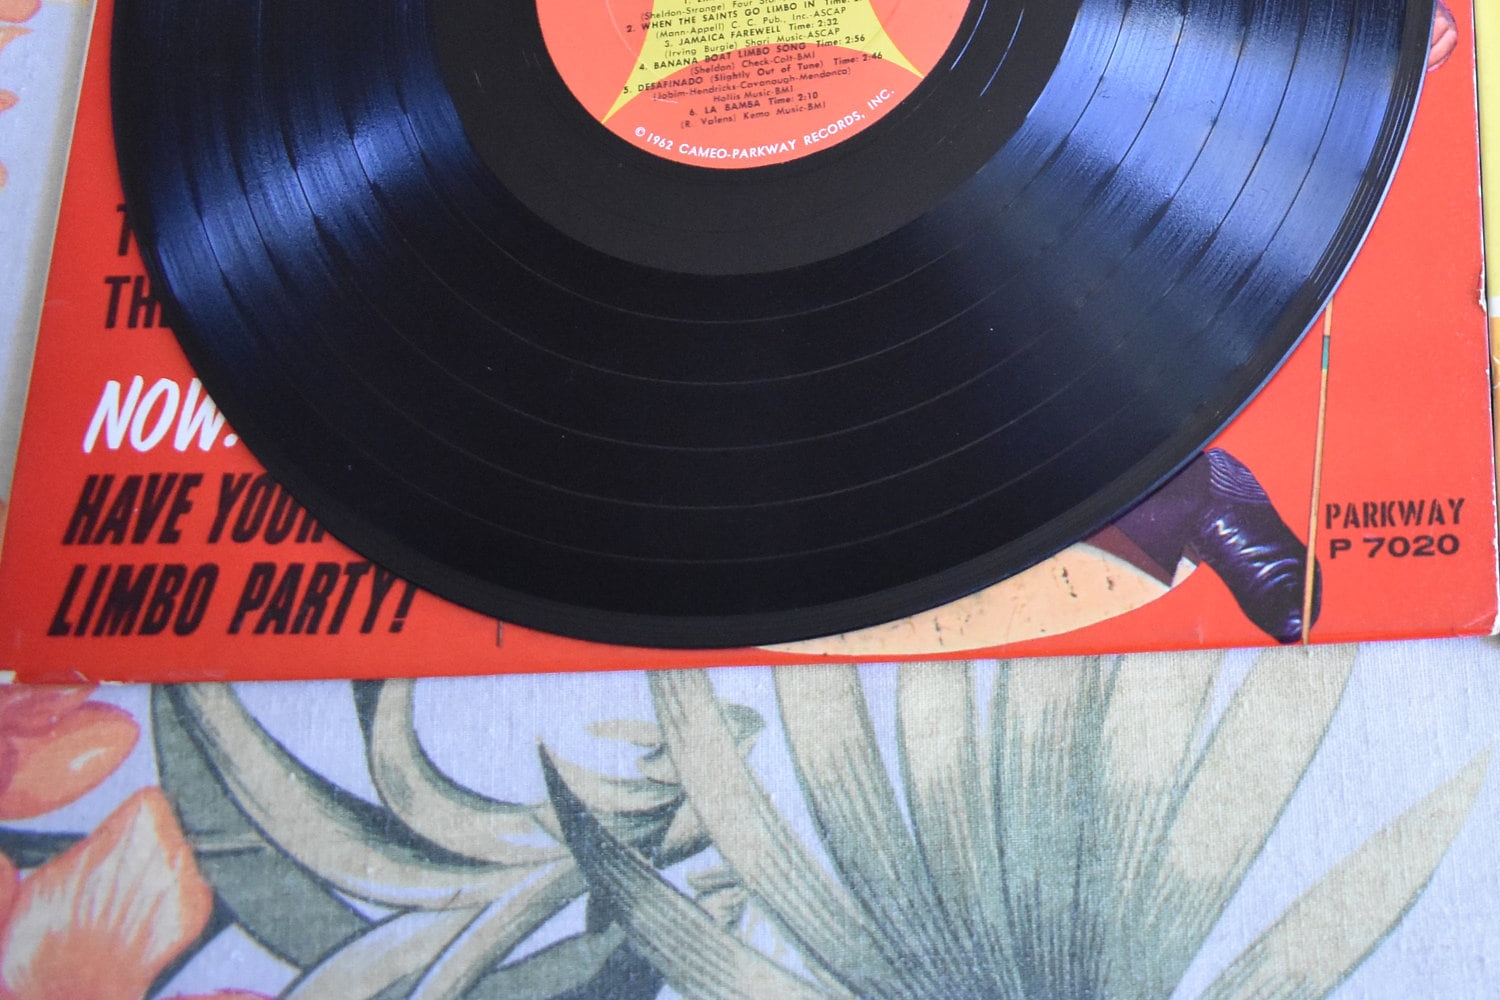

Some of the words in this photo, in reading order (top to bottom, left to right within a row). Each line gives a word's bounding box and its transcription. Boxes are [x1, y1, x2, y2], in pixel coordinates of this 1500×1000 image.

[641, 19, 671, 30] WHEN
[678, 16, 696, 25] THE
[702, 11, 738, 22] SAINTS
[744, 8, 760, 16] GO
[766, 3, 797, 14] LIMBO
[804, 0, 814, 9] IN
[678, 33, 724, 45] JAMAICA
[730, 25, 780, 38] FAREWELL
[788, 21, 814, 31] Time:
[817, 18, 838, 27] 2:32
[653, 56, 698, 69] BANANA
[704, 52, 730, 62] BOAT
[737, 47, 770, 58] LIMBO
[776, 42, 806, 53] SONG
[844, 34, 865, 44] 2:56
[637, 76, 702, 92] DESAFINADO
[756, 67, 774, 77] Out
[780, 64, 791, 73] of
[646, 132, 673, 150] 1962
[678, 139, 796, 159] CAMEO-PARKWAY
[803, 111, 865, 146] RECORDS,
[866, 88, 895, 110] INC.
[704, 106, 716, 114] LA
[103, 275, 170, 329] TH
[62, 472, 203, 545] HAVE
[1325, 498, 1465, 529] PARKWAY
[1329, 538, 1352, 559] P
[1363, 534, 1460, 558] 7020
[47, 562, 220, 638] LIMBO
[226, 562, 416, 635] PARTY!
